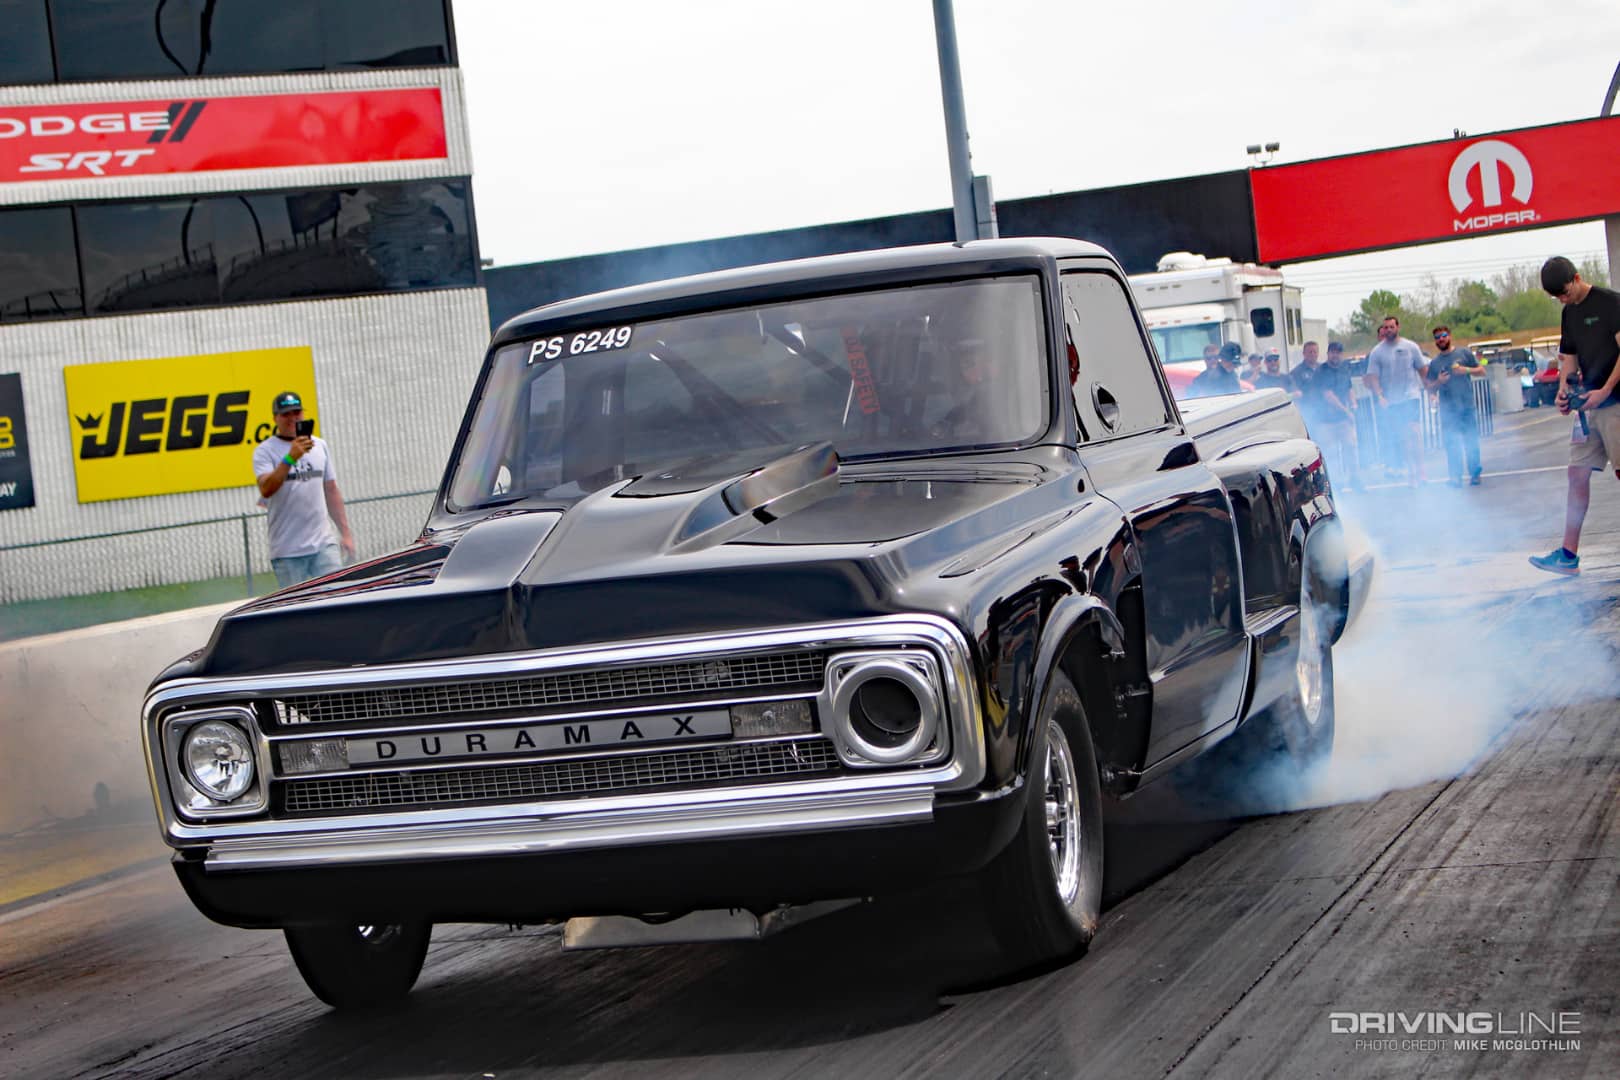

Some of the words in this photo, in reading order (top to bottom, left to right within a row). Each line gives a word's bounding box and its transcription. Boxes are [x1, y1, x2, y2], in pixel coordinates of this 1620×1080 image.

[19, 148, 156, 175] SRT
[528, 336, 564, 364] PS
[570, 326, 632, 355] 6249
[376, 716, 696, 760] DURAMAX
